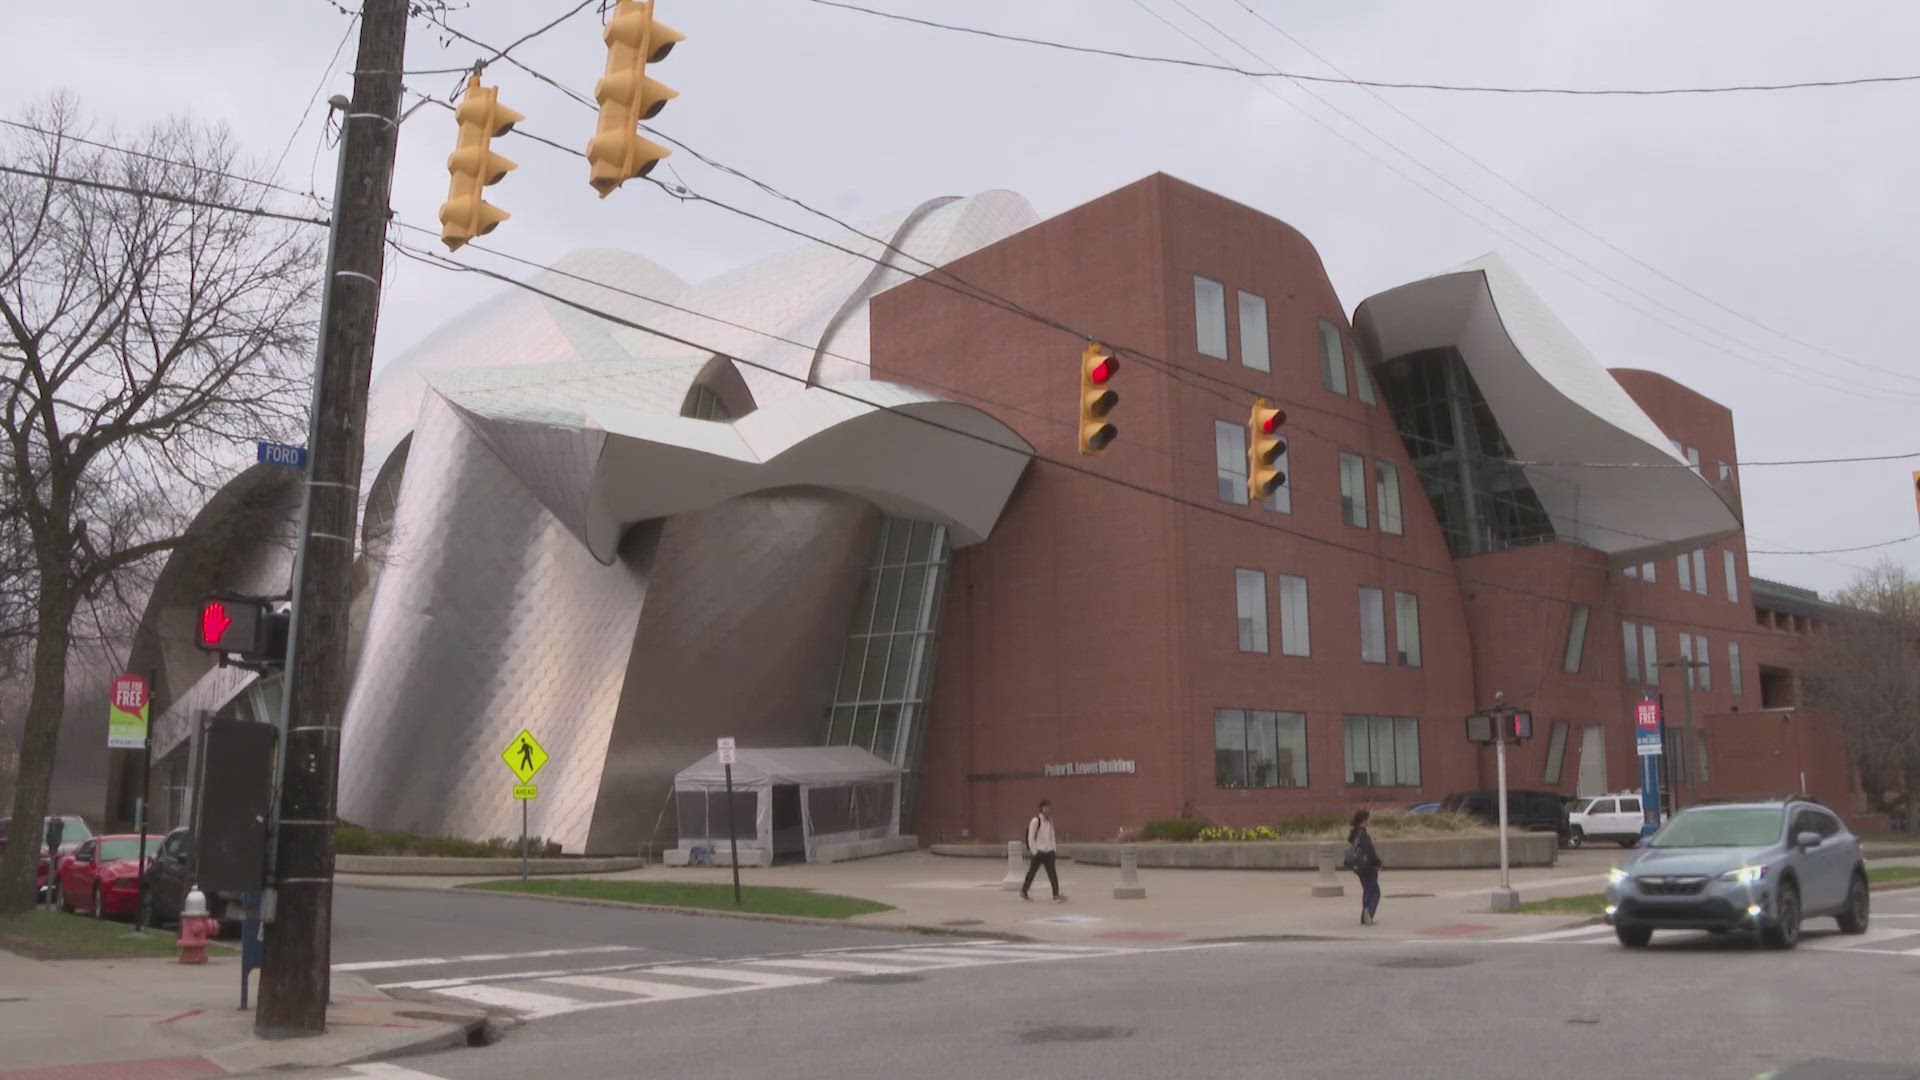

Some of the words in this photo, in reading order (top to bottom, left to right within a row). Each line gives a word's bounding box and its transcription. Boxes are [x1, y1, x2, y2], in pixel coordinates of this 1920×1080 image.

[265, 444, 299, 465] FORD
[131, 681, 143, 691] FOR
[116, 690, 143, 707] FREE
[1639, 712, 1657, 724] FREE
[1044, 763, 1067, 776] Peter
[1076, 761, 1098, 775] Lewis
[1099, 758, 1136, 774] Building
